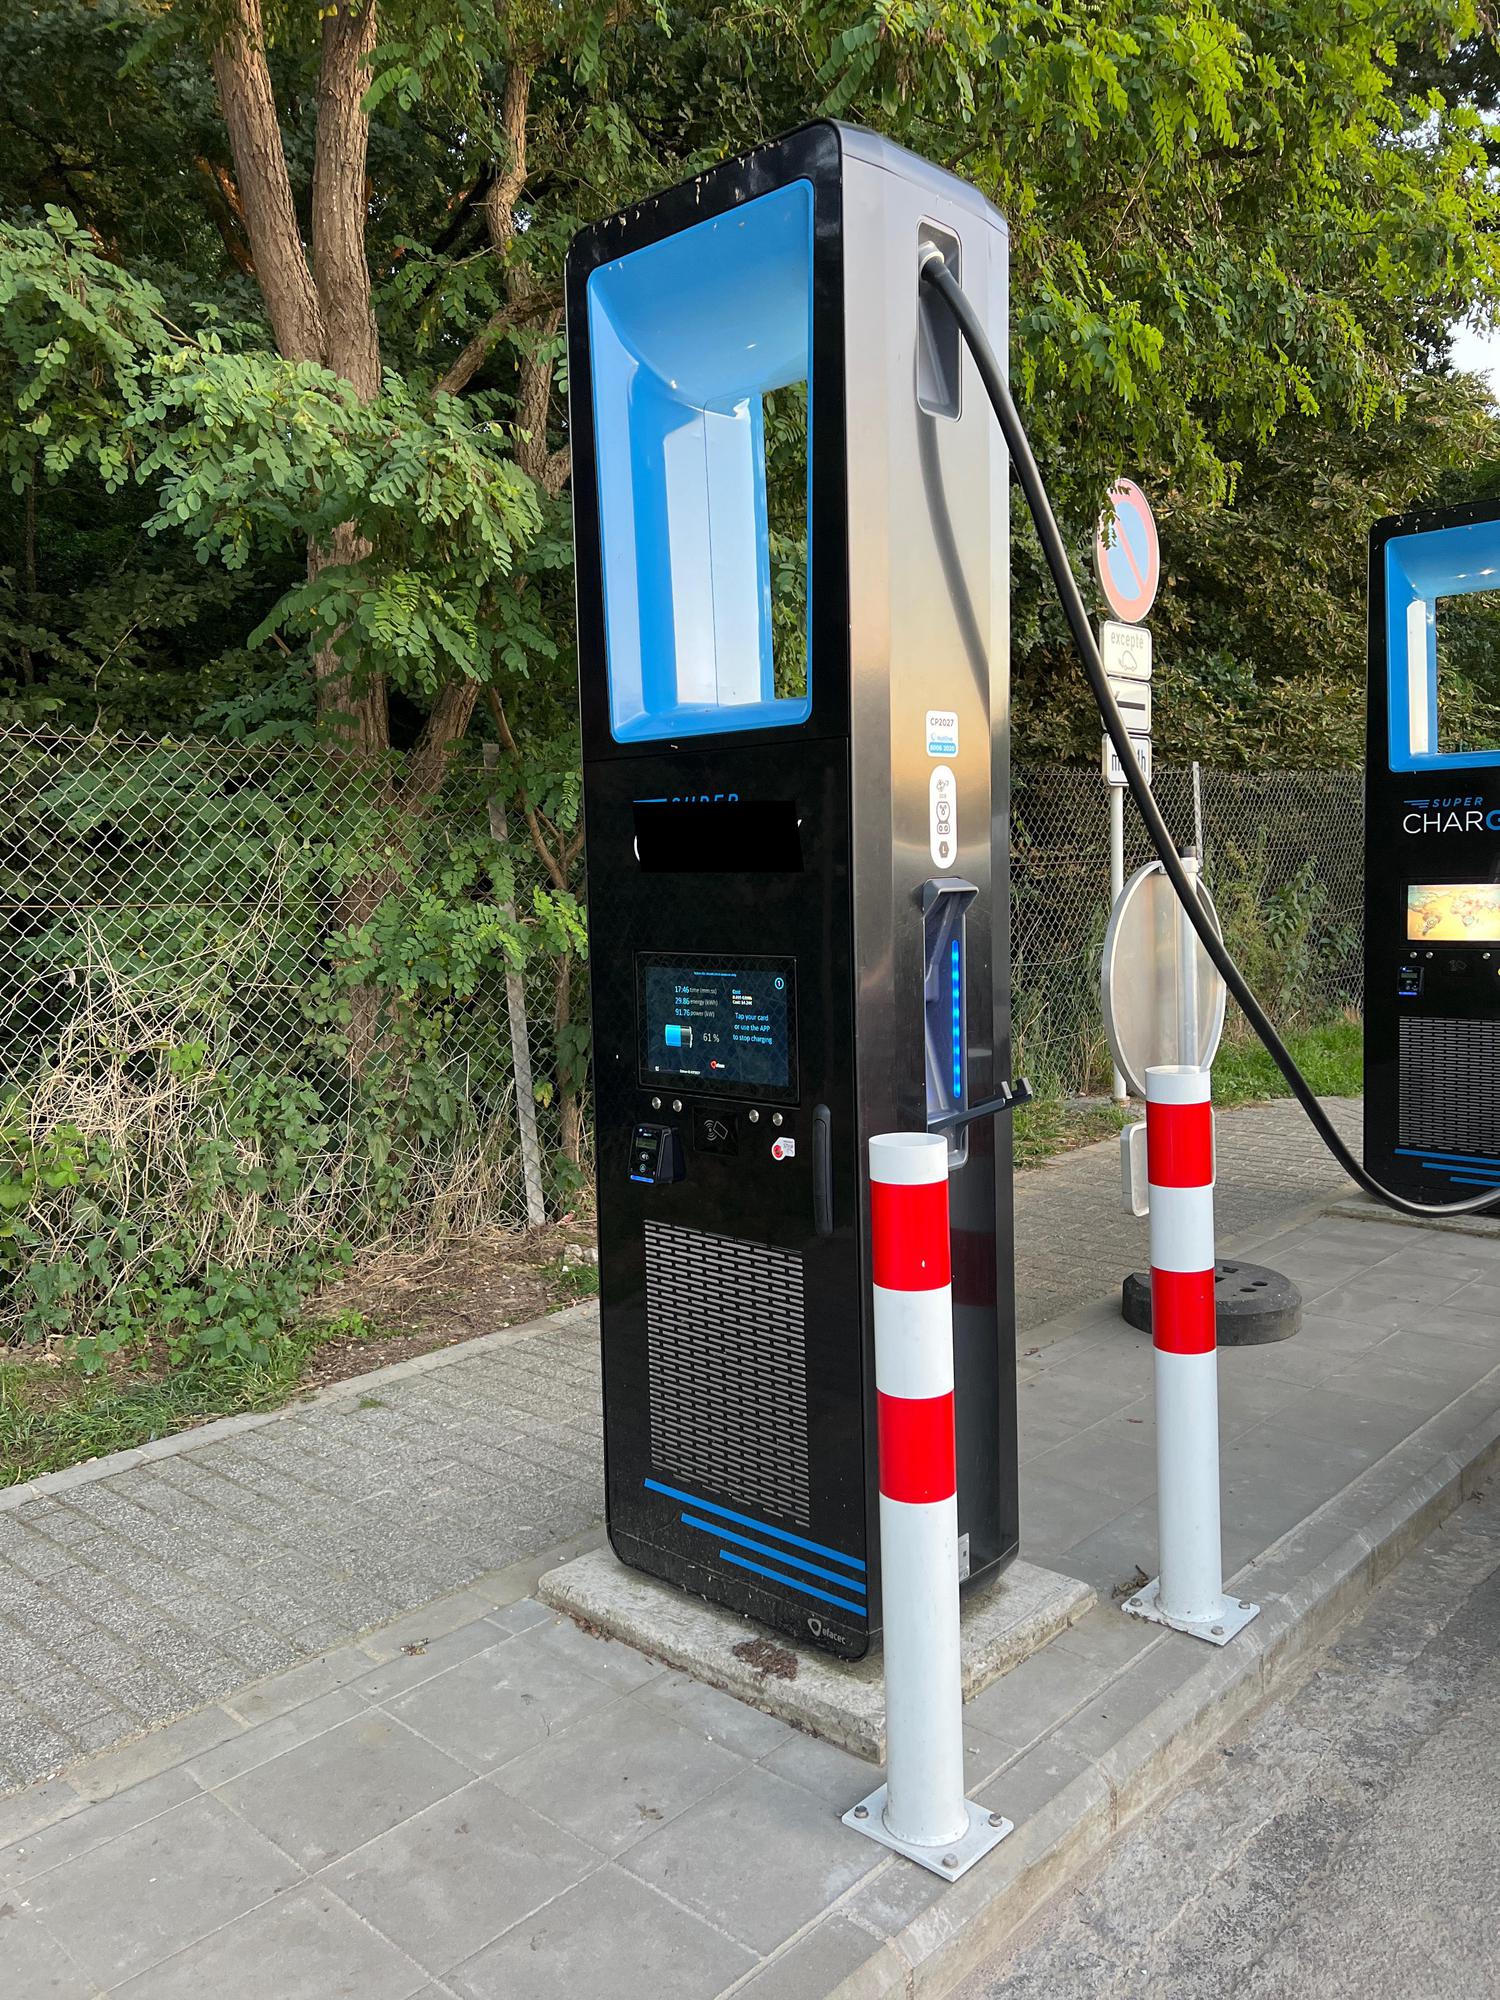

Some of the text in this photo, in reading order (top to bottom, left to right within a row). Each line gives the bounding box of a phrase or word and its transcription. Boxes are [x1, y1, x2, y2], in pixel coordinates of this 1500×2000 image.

[1111, 631, 1144, 650] excepté
[930, 717, 954, 727] CP2027
[1432, 796, 1484, 808] SUPER
[735, 1012, 745, 1021] Tap
[703, 1033, 720, 1043] 61 %
[739, 1035, 751, 1043] stop
[751, 1035, 773, 1045] charging
[822, 1627, 846, 1645] efacec
